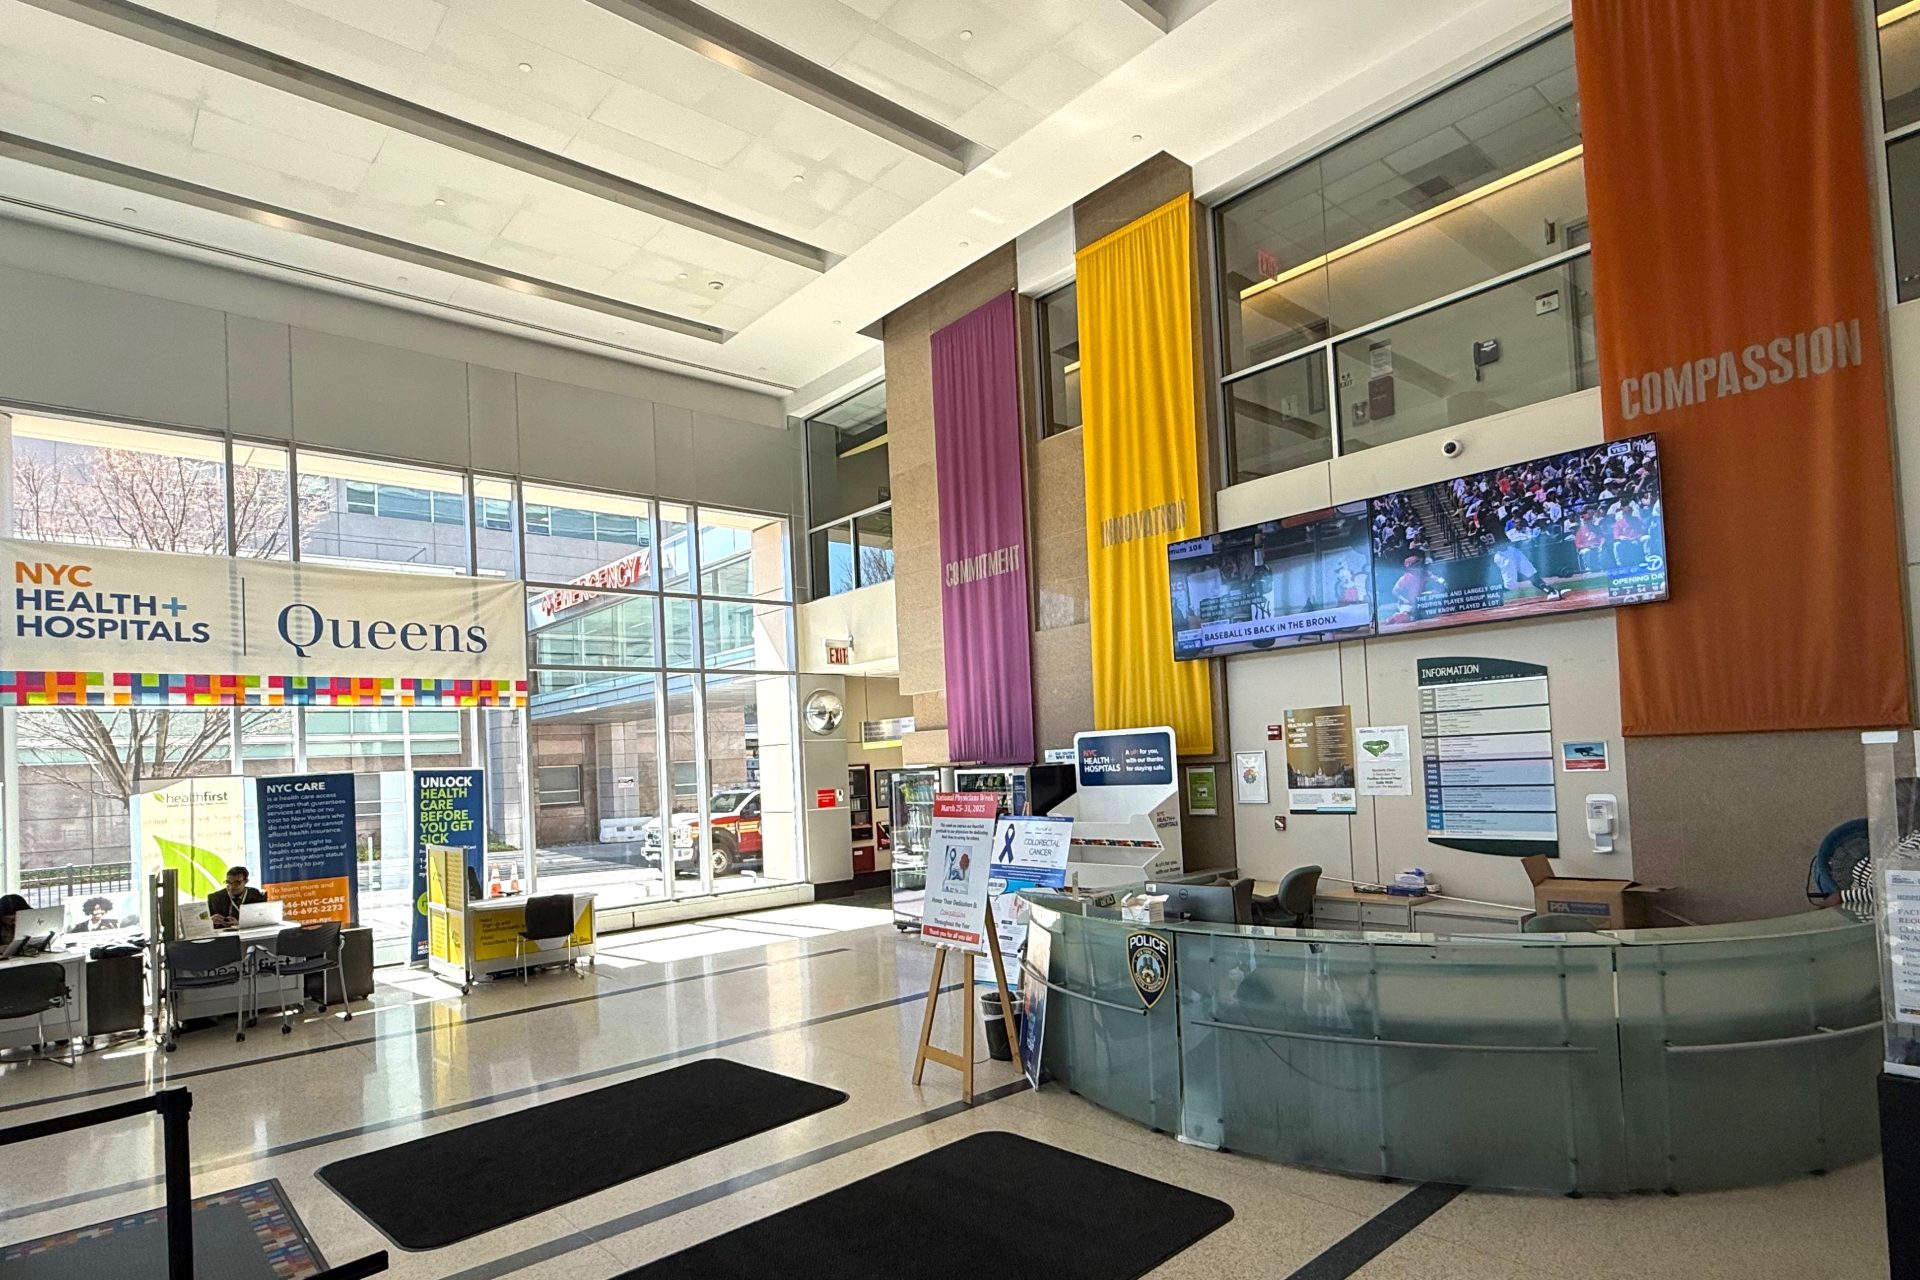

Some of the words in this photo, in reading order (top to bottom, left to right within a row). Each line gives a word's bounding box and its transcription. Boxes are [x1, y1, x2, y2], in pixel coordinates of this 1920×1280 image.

[1620, 319, 1862, 421] COMPASSION
[946, 545, 1019, 587] COMMITMENT
[16, 561, 92, 587] NYC
[1612, 575, 1649, 585] OPENING
[17, 615, 210, 643] HOSPITALS
[278, 603, 488, 658] Queens
[1205, 628, 1242, 642] BASEBALL
[1245, 628, 1252, 636] IS
[1254, 624, 1275, 635] BACK
[1278, 623, 1286, 631] IN
[1288, 621, 1304, 630] THE
[1307, 615, 1337, 627] BRONX
[830, 648, 847, 664] EXIT
[1422, 664, 1479, 678] INFORMATION
[1085, 764, 1120, 773] HOSPITALS
[421, 776, 472, 788] UNLOCK
[267, 785, 292, 794] NYC
[294, 782, 326, 791] CARE
[420, 788, 467, 799] HEALTH
[955, 794, 979, 802] Physicians
[267, 802, 295, 810] program
[420, 799, 454, 810] CARE
[941, 804, 956, 812] March
[972, 805, 985, 813] 2025
[420, 810, 469, 821] BEFORE
[420, 822, 447, 833] YOU
[451, 820, 474, 831] GET
[420, 833, 449, 845] SICK
[1024, 838, 1060, 847] COLORECTAL
[306, 845, 340, 853] regardless
[1029, 848, 1052, 856] CANCER
[286, 854, 324, 862] immigration
[282, 861, 303, 869] ability
[1130, 935, 1167, 955] POLICE
